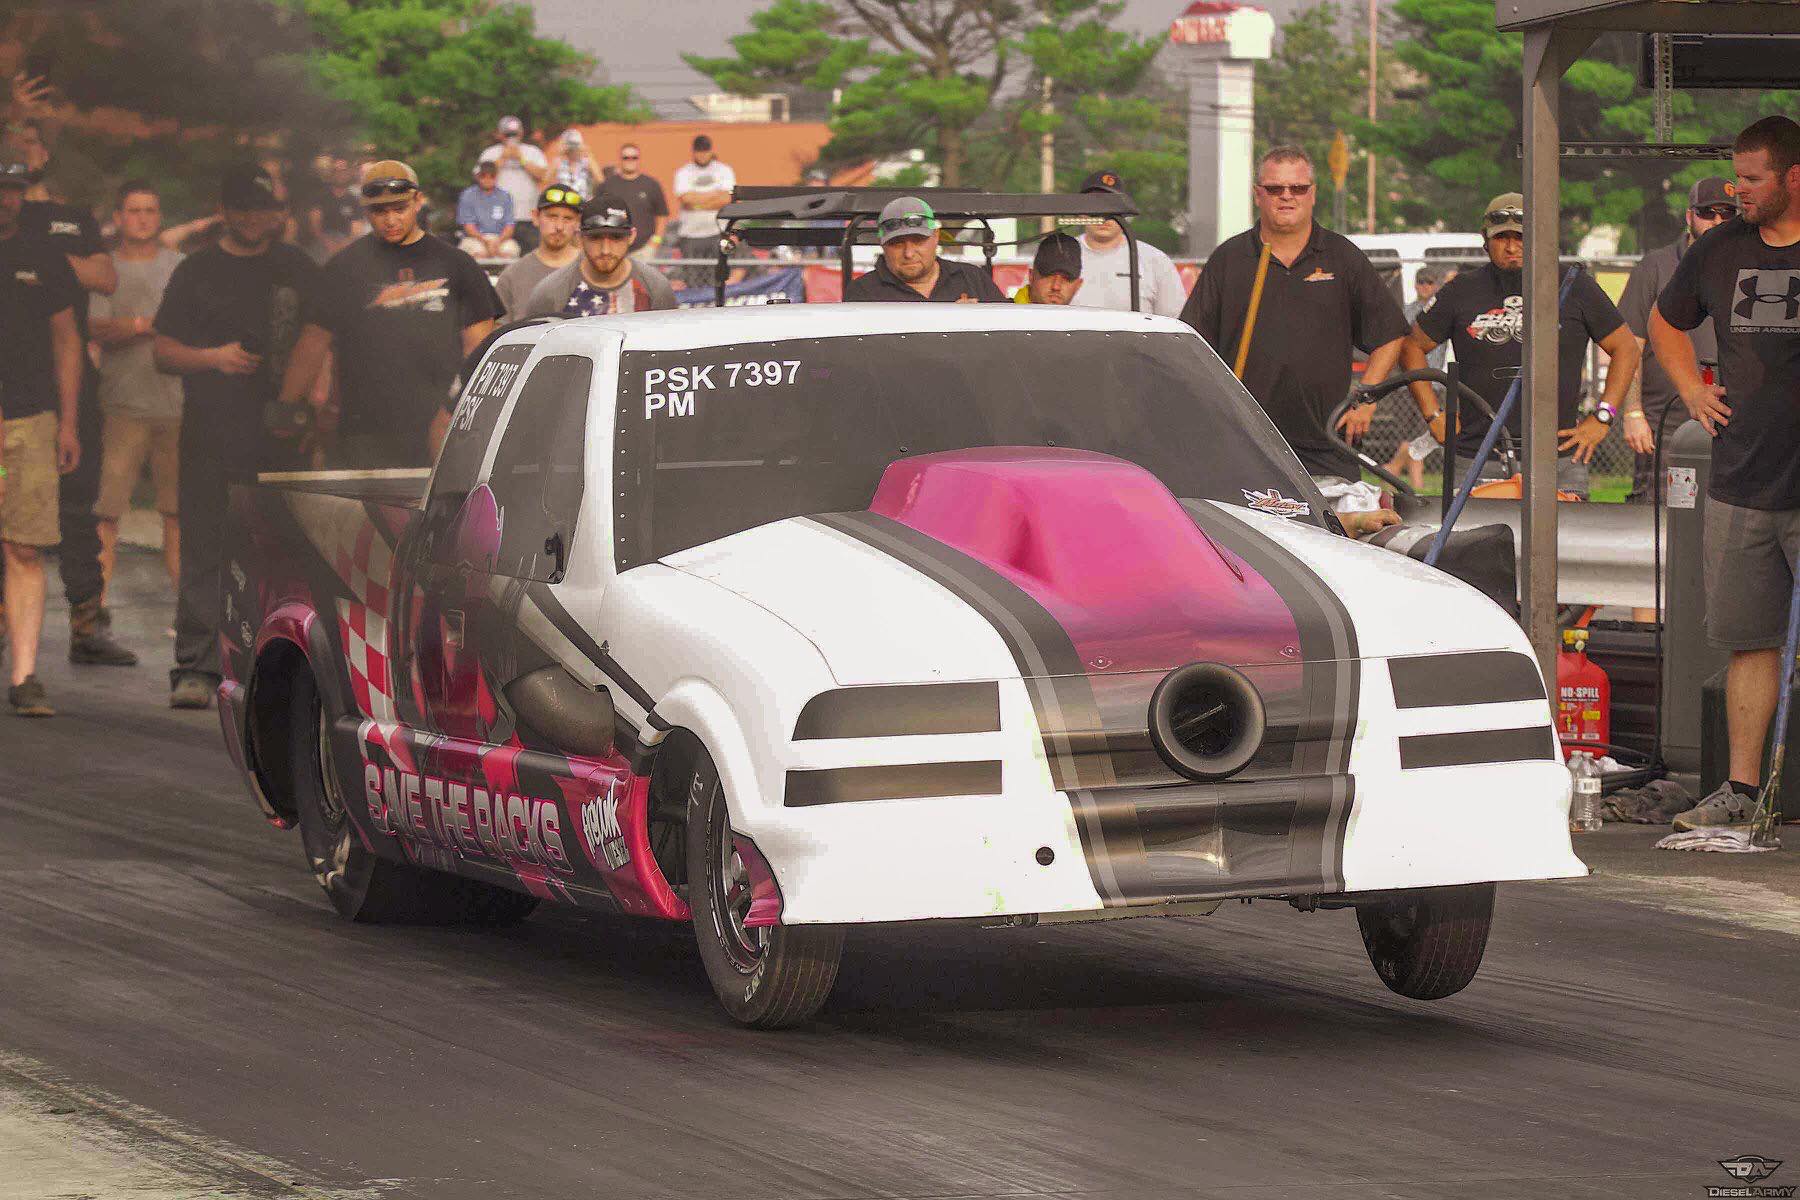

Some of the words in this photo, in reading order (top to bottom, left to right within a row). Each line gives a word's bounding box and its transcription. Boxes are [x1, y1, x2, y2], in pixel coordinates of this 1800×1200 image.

[1730, 326, 1760, 334] UNDER
[1762, 326, 1800, 335] ARMOU
[472, 361, 501, 395] PM
[487, 363, 519, 398] 7397
[645, 364, 717, 395] PSK
[724, 360, 801, 389] 7397
[454, 395, 484, 431] PSK
[645, 391, 695, 420] PM
[364, 763, 436, 847] SAVE
[424, 776, 496, 857] THE
